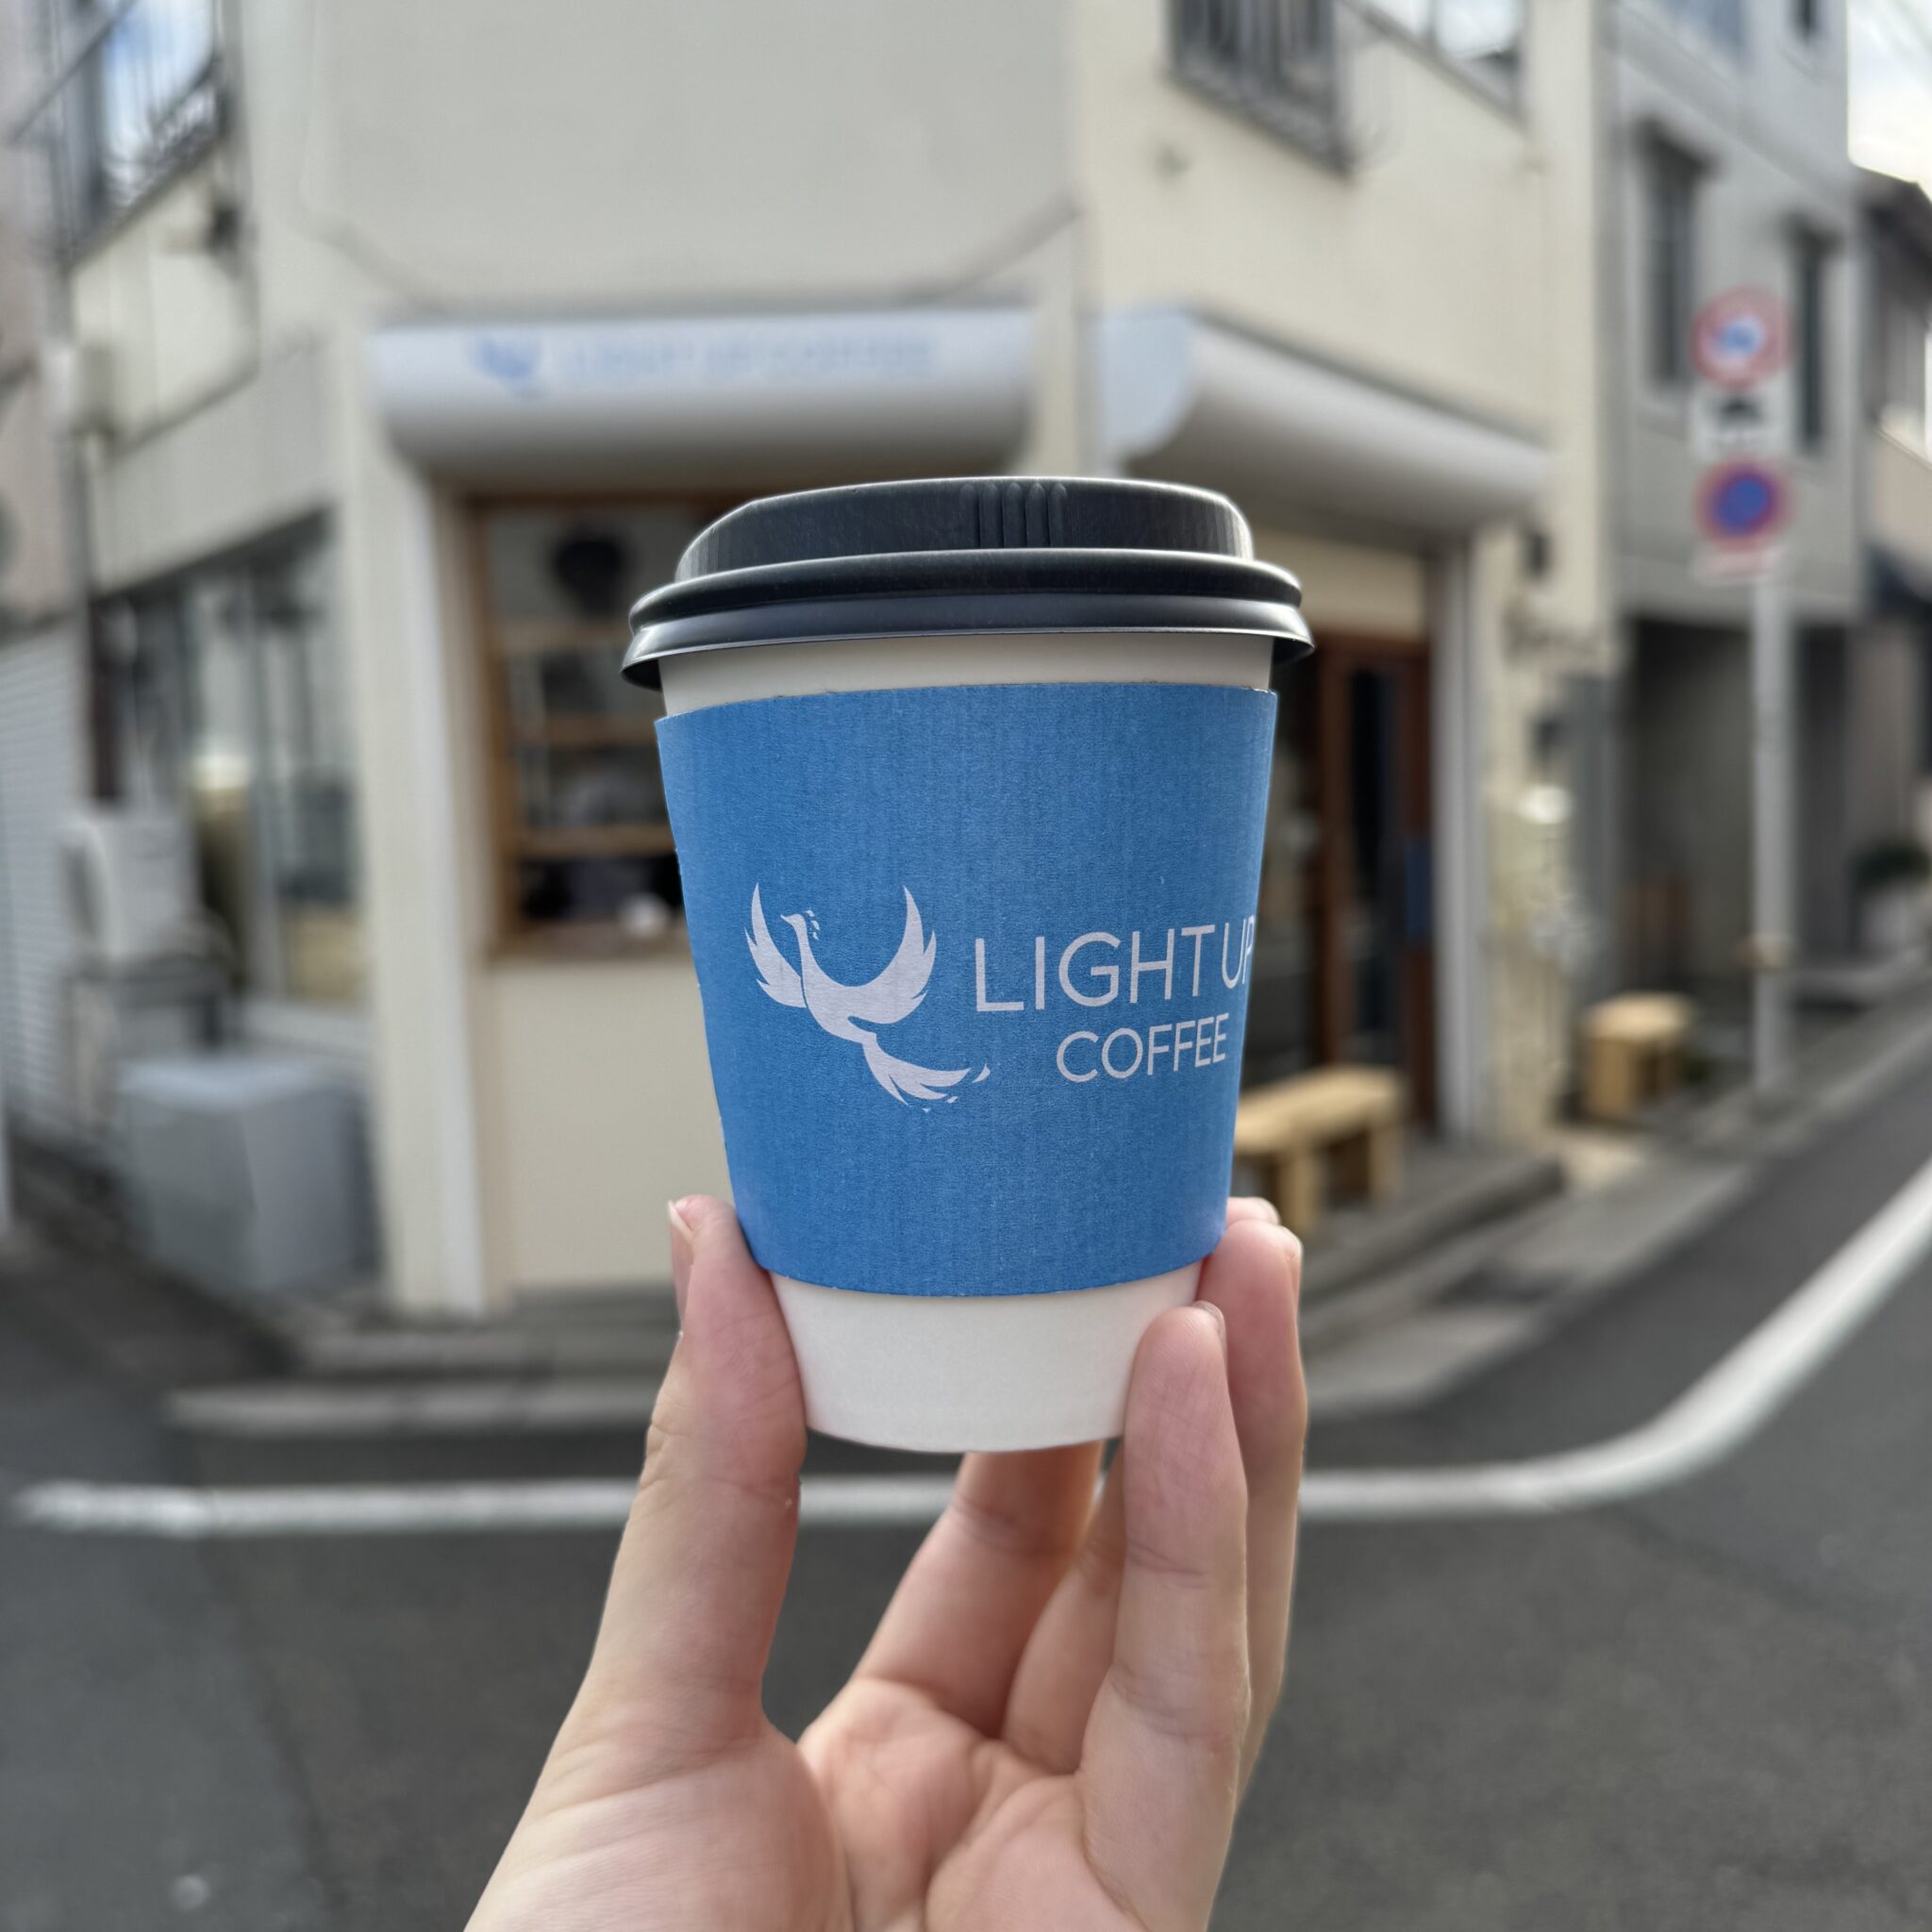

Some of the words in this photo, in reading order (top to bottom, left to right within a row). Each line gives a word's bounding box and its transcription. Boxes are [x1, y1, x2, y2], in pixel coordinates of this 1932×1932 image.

[975, 924, 1215, 1011] LIGHT
[1222, 915, 1255, 989] UP
[1057, 1012, 1229, 1082] COFFEE
